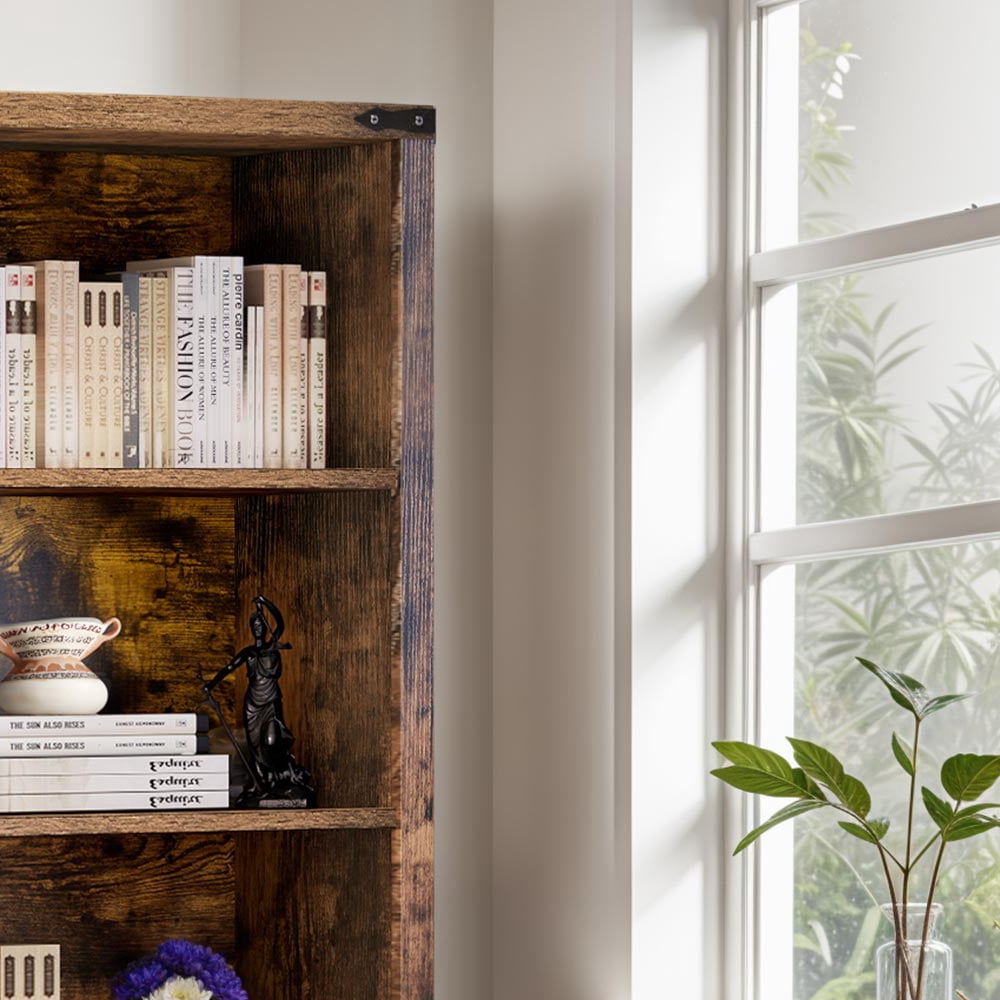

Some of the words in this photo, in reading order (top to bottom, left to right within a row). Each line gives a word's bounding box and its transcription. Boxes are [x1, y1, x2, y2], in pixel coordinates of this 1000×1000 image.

[177, 269, 194, 312] THE
[222, 268, 230, 288] THE
[233, 274, 243, 309] pierre
[222, 290, 230, 329] ALLURE
[235, 313, 243, 350] cardin
[177, 316, 194, 402] FASHION
[222, 347, 230, 386] BEAUTY
